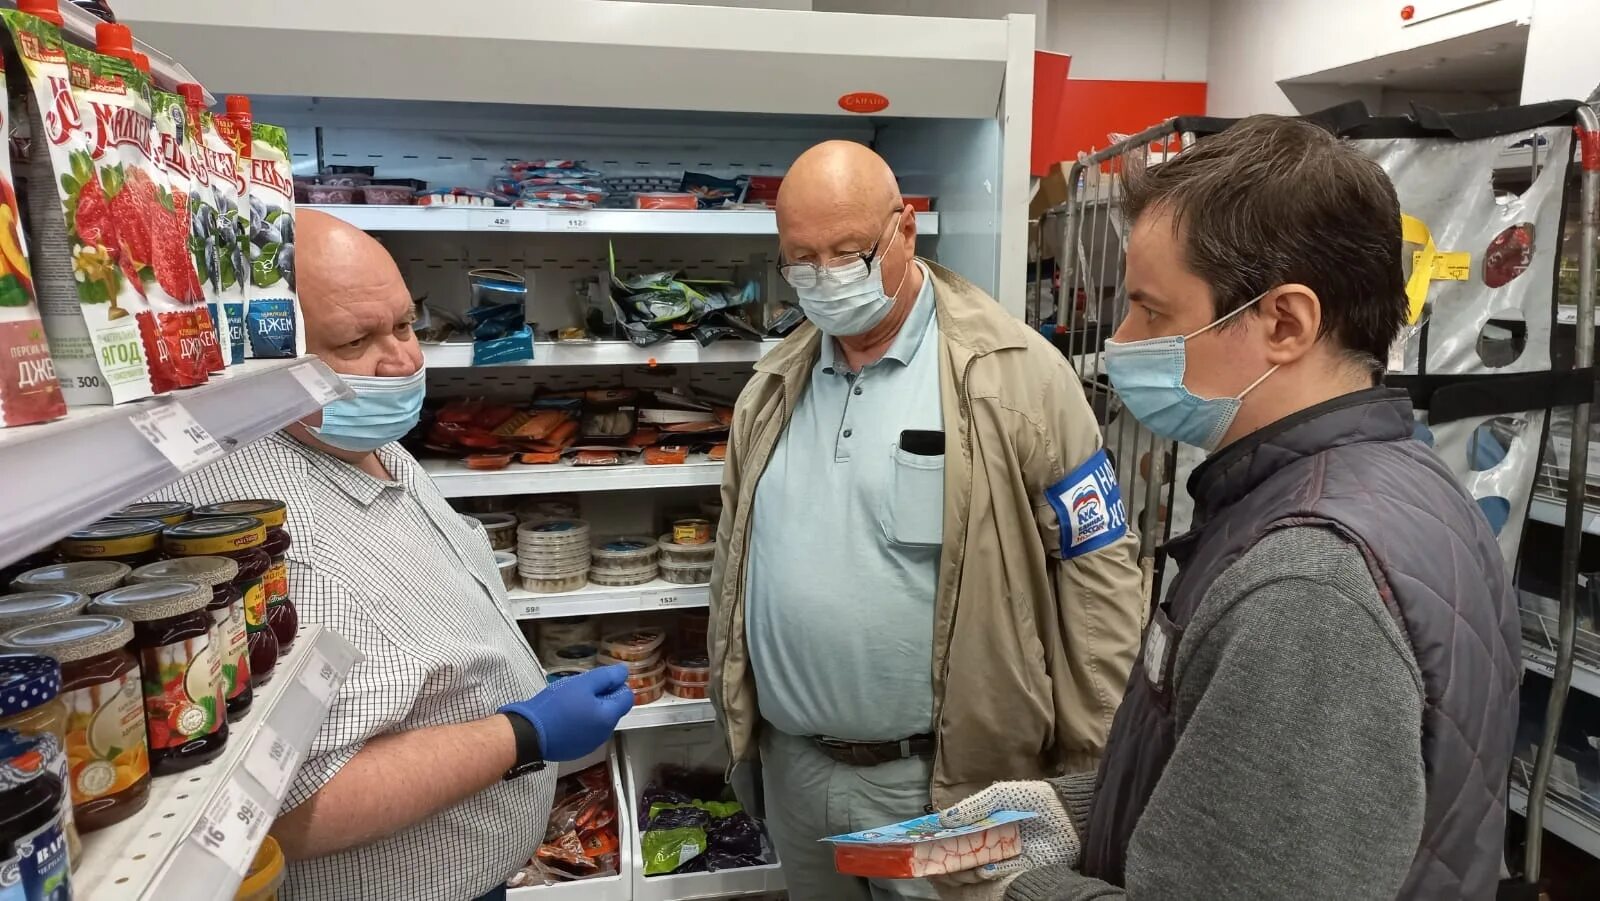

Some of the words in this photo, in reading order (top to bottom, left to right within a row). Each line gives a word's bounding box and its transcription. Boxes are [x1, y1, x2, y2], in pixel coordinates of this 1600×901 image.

[258, 317, 295, 336] ДЖЕМ
[101, 341, 143, 367] ЯГОД
[77, 375, 99, 389] 300
